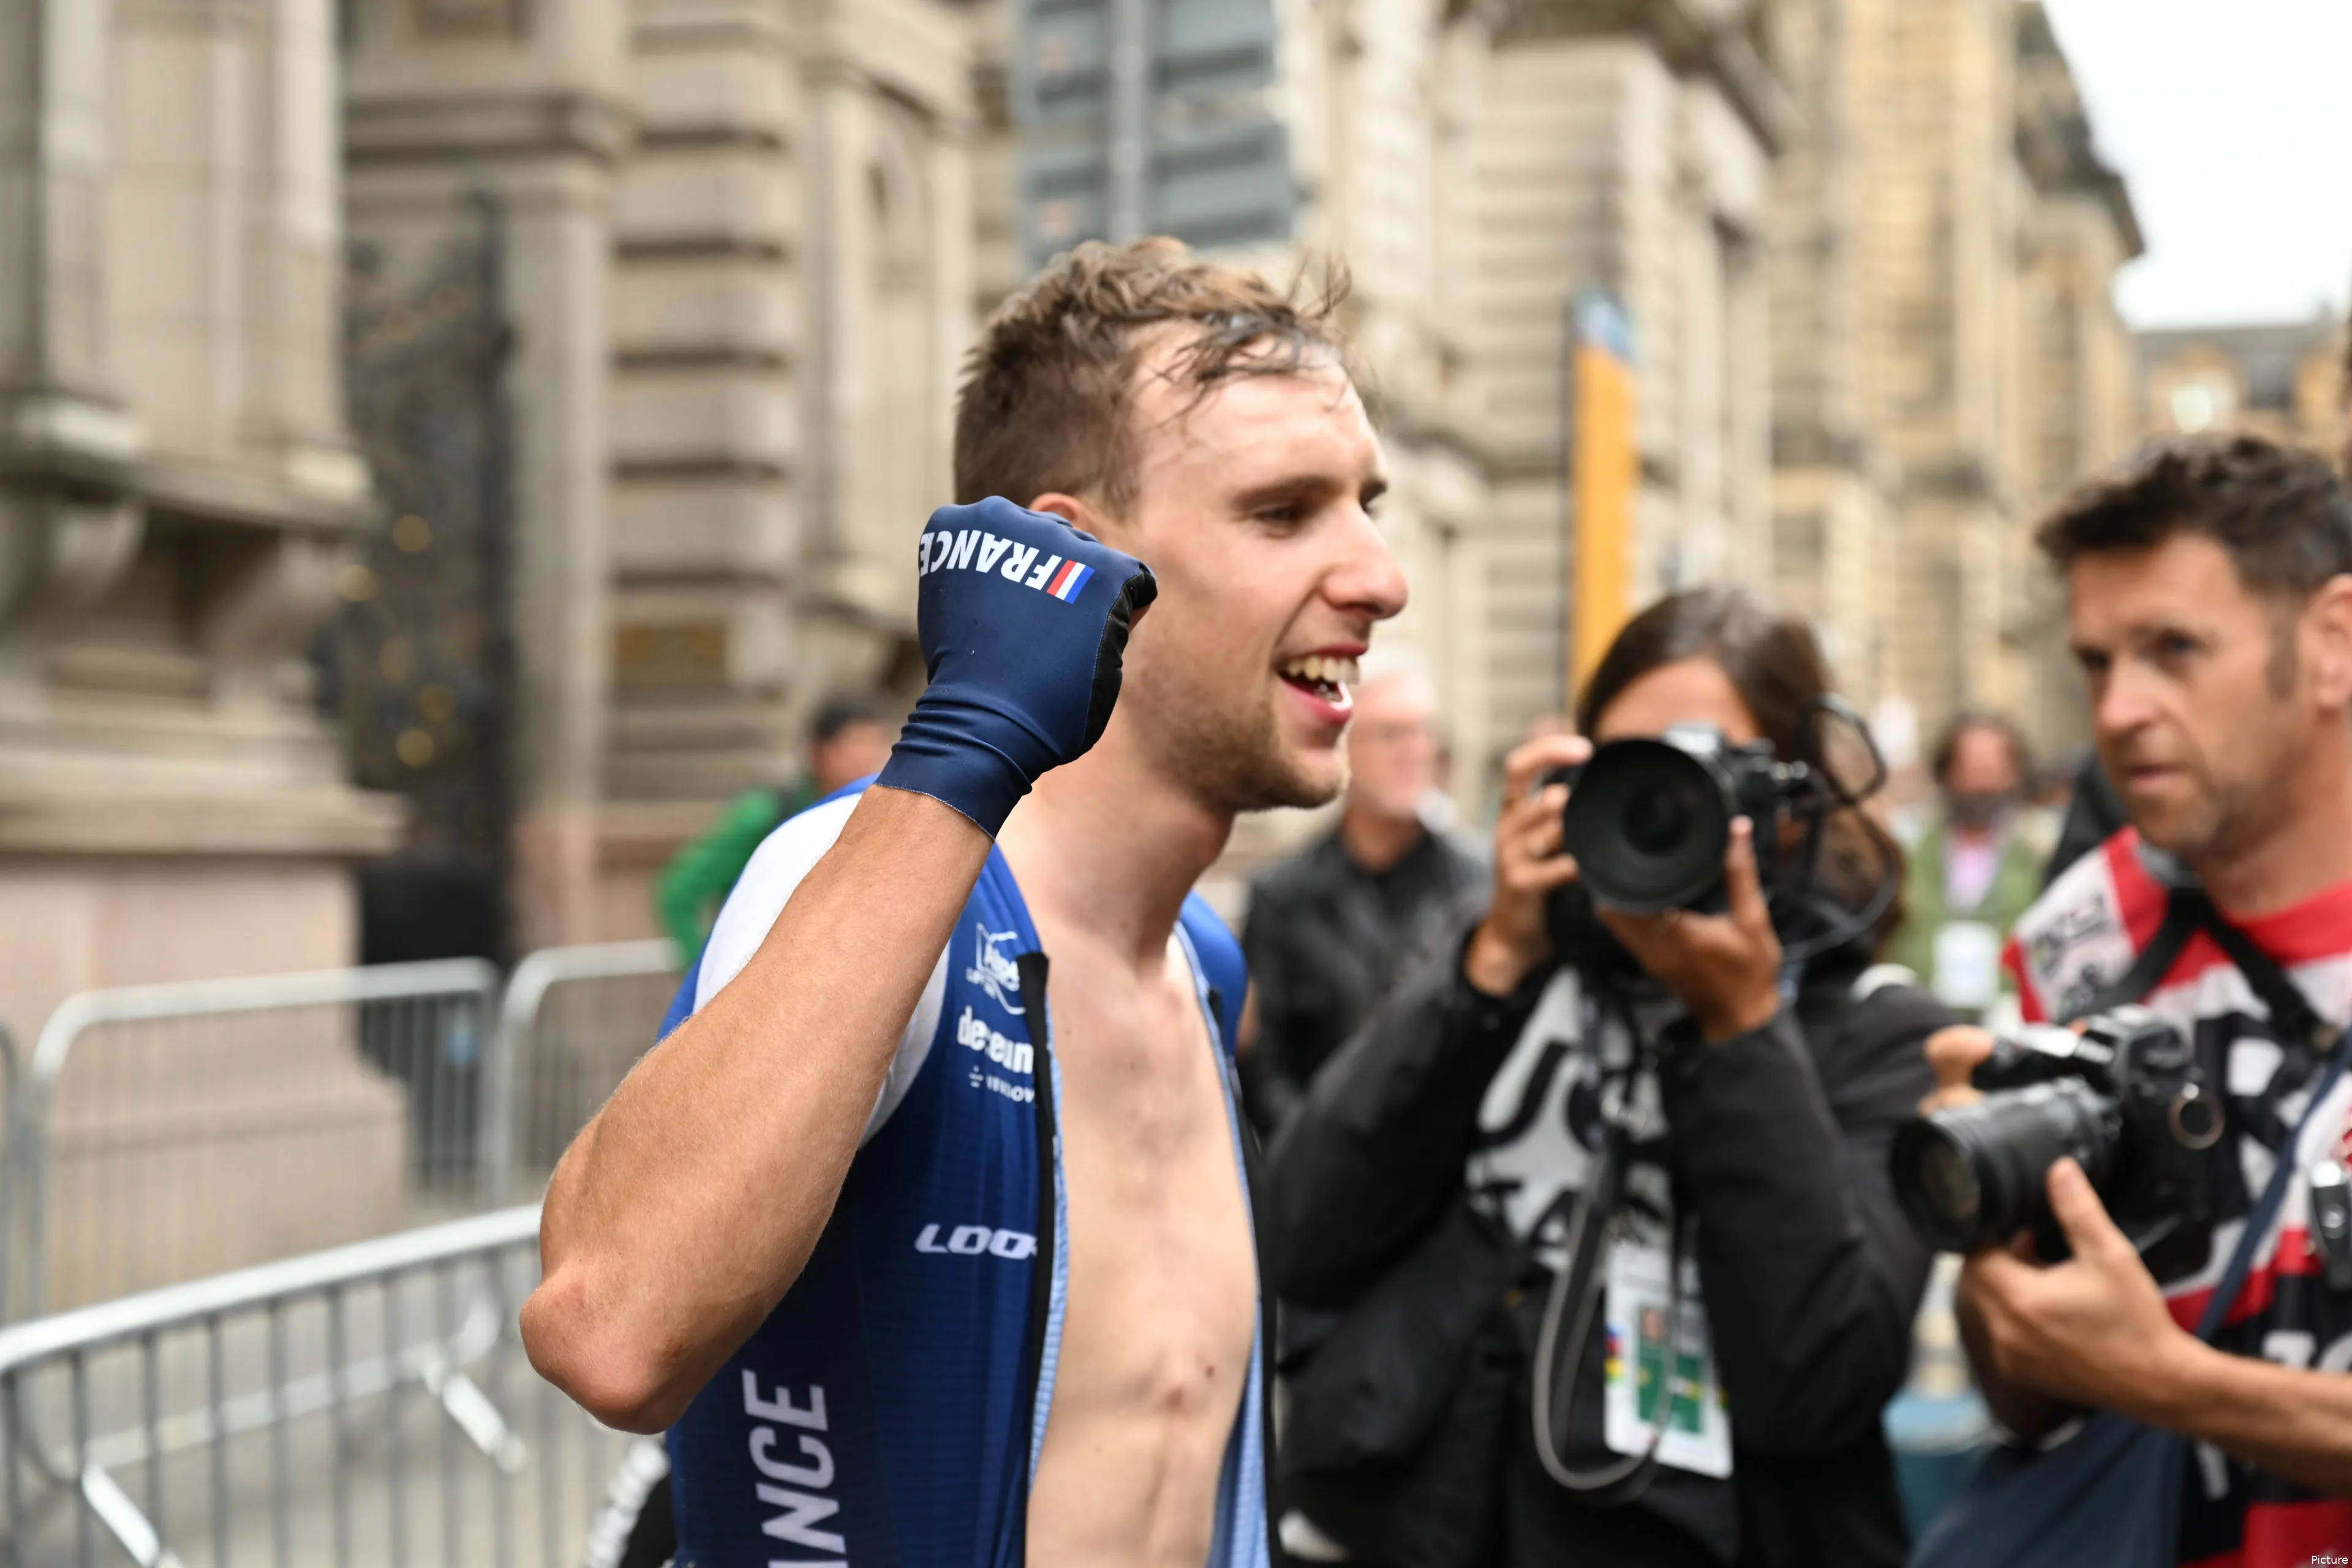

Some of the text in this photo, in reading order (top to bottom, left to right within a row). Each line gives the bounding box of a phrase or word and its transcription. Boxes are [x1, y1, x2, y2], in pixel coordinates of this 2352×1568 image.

[919, 529, 1062, 590] FRANCE
[914, 1223, 1037, 1260] LOO
[741, 1369, 849, 1568] NCE
